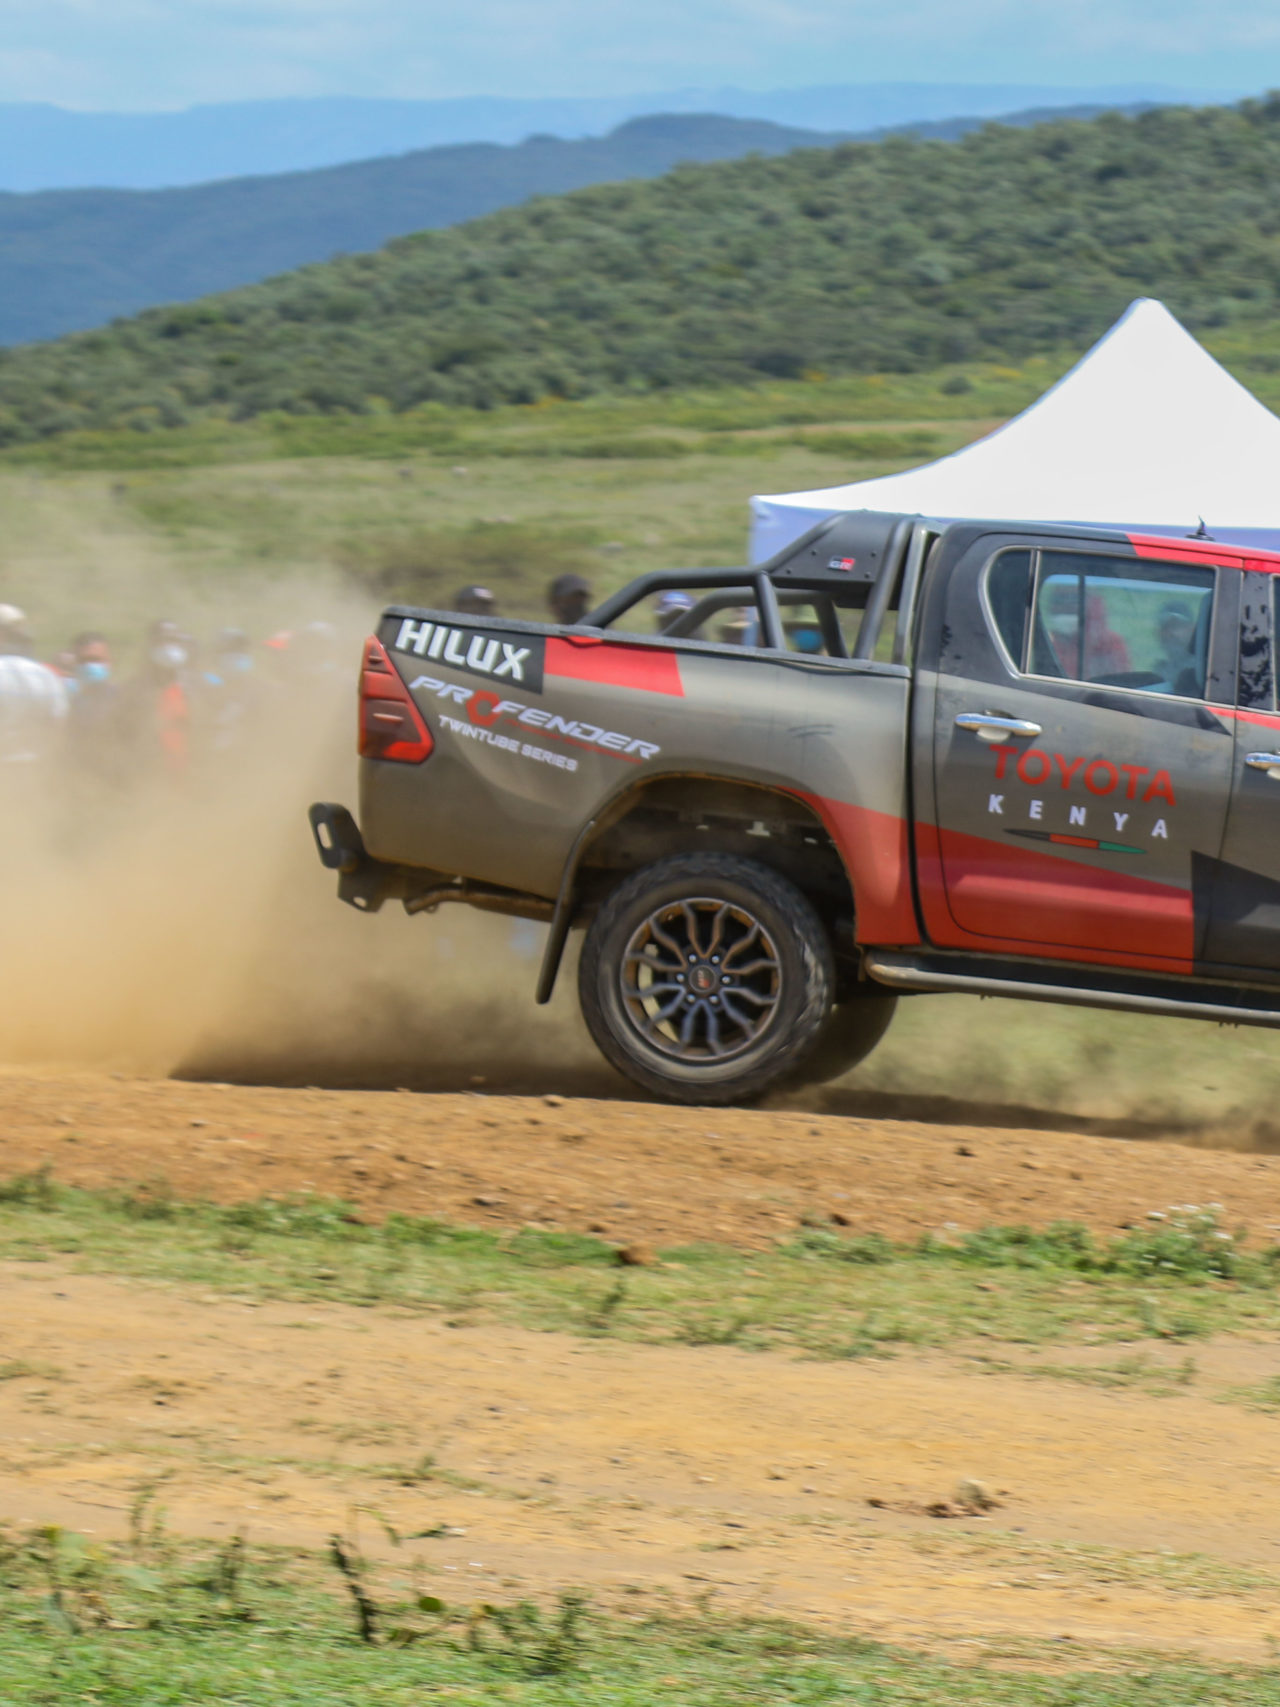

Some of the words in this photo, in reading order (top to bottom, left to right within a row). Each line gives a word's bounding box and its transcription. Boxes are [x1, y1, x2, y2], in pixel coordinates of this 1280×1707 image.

[395, 618, 531, 681] HILUX
[409, 675, 661, 759] PROFENDER
[438, 714, 520, 754] TWINTUBE
[521, 743, 578, 772] SERIES
[989, 744, 1177, 806] TOYOTA
[988, 794, 1168, 839] KENYA
